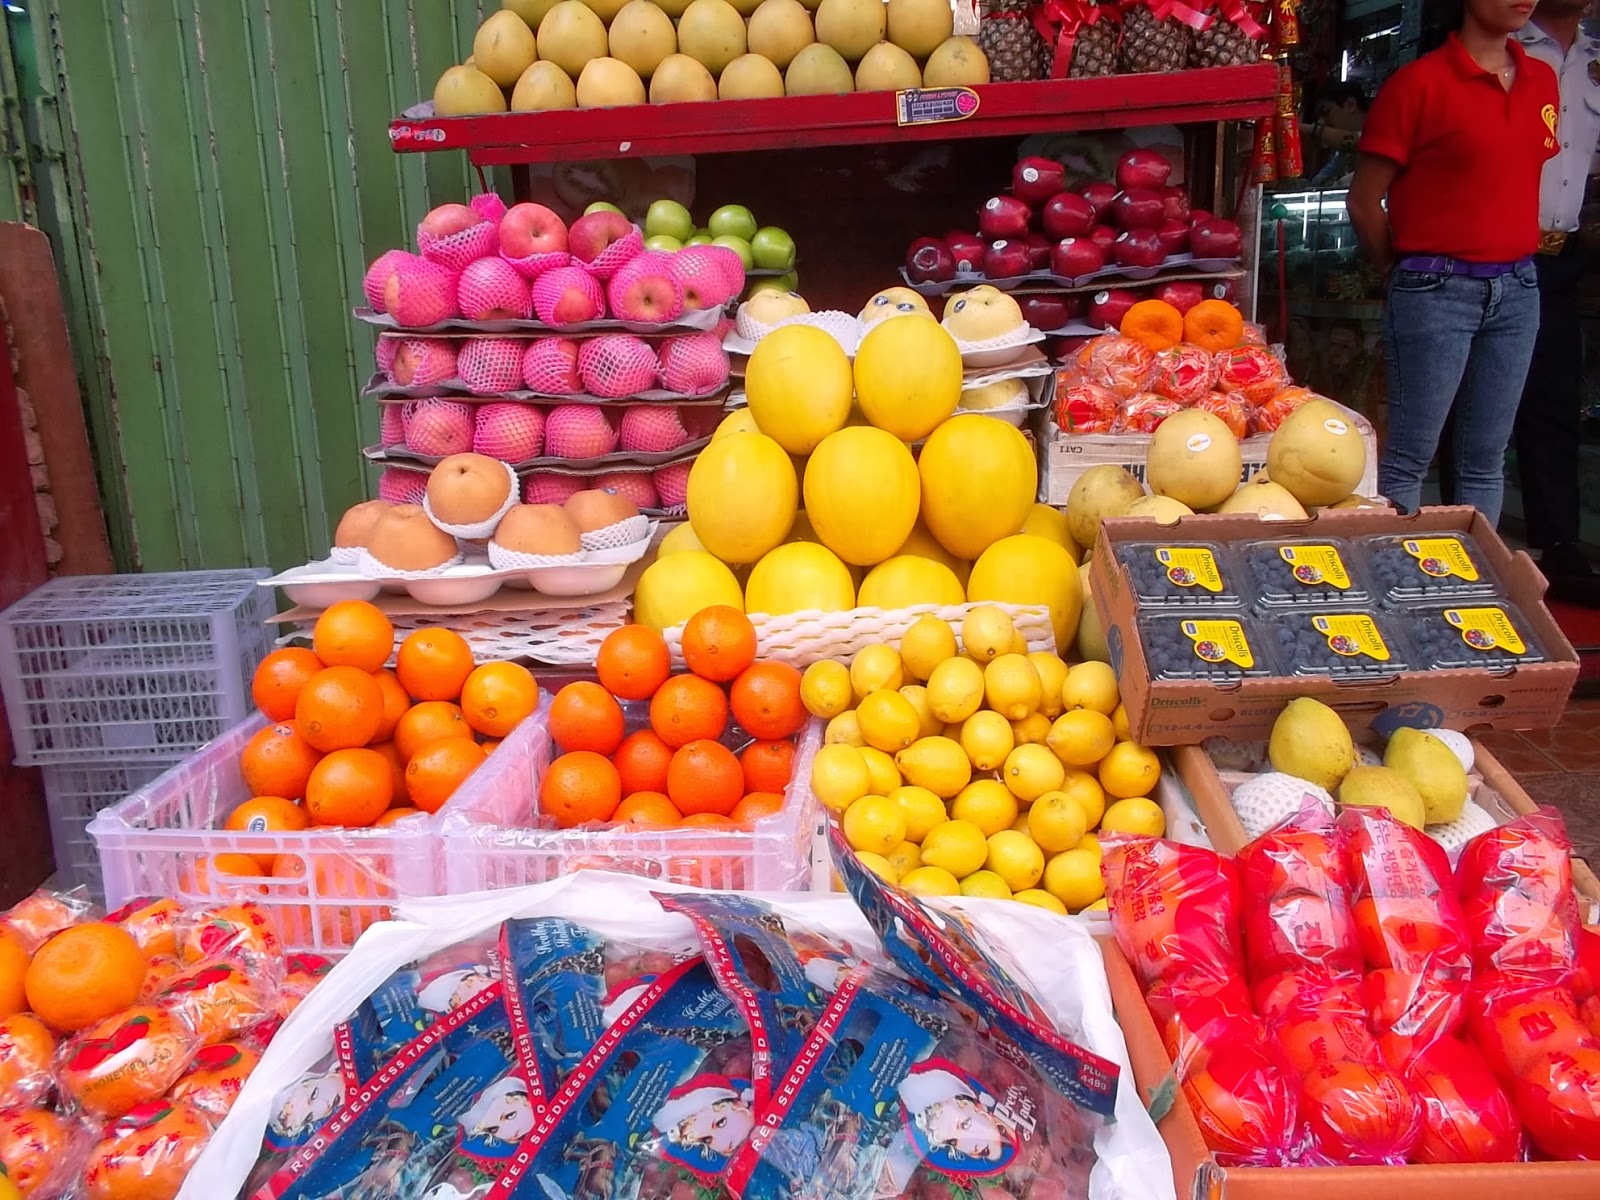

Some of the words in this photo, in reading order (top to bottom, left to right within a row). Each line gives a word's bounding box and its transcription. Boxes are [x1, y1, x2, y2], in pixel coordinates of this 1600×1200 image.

[504, 957, 517, 992] GRAPE
[921, 926, 969, 980] ROUGES
[976, 984, 1017, 1018] SANS
[511, 996, 525, 1029] TABLE
[700, 998, 731, 1020] Holid
[340, 1022, 356, 1081] SEEDLE
[519, 1034, 542, 1096] SEEDLESS
[752, 1113, 778, 1151] RED
[778, 1035, 824, 1106] SEEDLESS
[824, 992, 850, 1029] TABLE
[758, 1037, 768, 1077] RED
[291, 1137, 325, 1174] RED
[330, 1059, 406, 1134] SEEDLESS
[406, 1024, 445, 1059] TABLE
[448, 989, 496, 1028] GRAPES
[502, 1151, 530, 1188] RED
[531, 1069, 585, 1144] SEEDLESS
[586, 1028, 621, 1068] TABLE
[621, 983, 663, 1028] GRAPES
[993, 1083, 1028, 1130] Pretty
[1010, 1095, 1037, 1141] Lady
